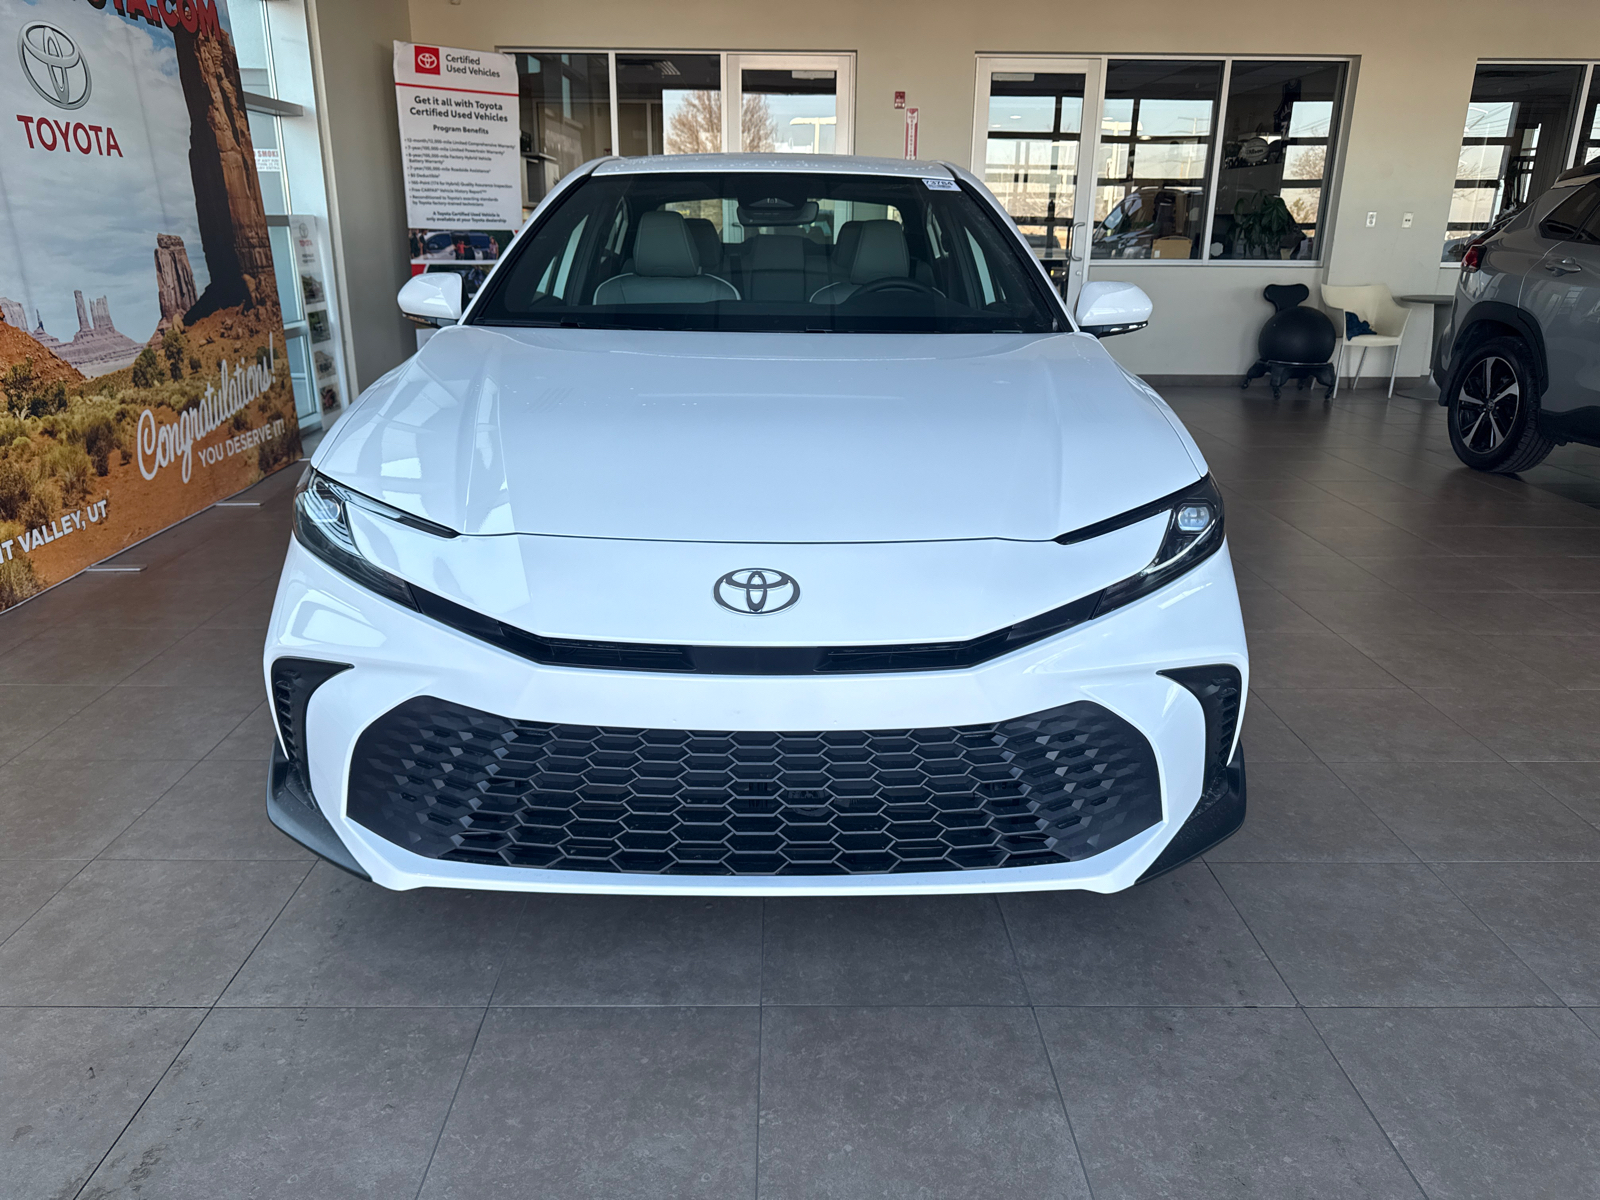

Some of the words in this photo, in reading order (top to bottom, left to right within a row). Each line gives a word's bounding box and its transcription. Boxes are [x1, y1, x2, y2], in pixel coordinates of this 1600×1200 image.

[445, 54, 480, 66] Certified
[446, 65, 467, 74] Used
[468, 67, 500, 78] Vehicles
[414, 96, 432, 104] Get
[432, 96, 440, 106] it
[441, 98, 452, 107] all
[454, 100, 474, 108] with
[475, 101, 503, 112] Toyota
[410, 107, 449, 118] Certified
[450, 110, 472, 120] Used
[473, 112, 508, 122] Vehicles
[16, 115, 123, 158] TOYOTA
[433, 124, 462, 134] Program
[462, 126, 489, 135] Benefits
[137, 331, 276, 484] Congratulations!
[198, 443, 224, 468] YOU
[226, 424, 272, 457] DESERVE
[272, 418, 286, 438] IT!
[17, 509, 86, 554] VALLEY,
[86, 499, 107, 523] UT
